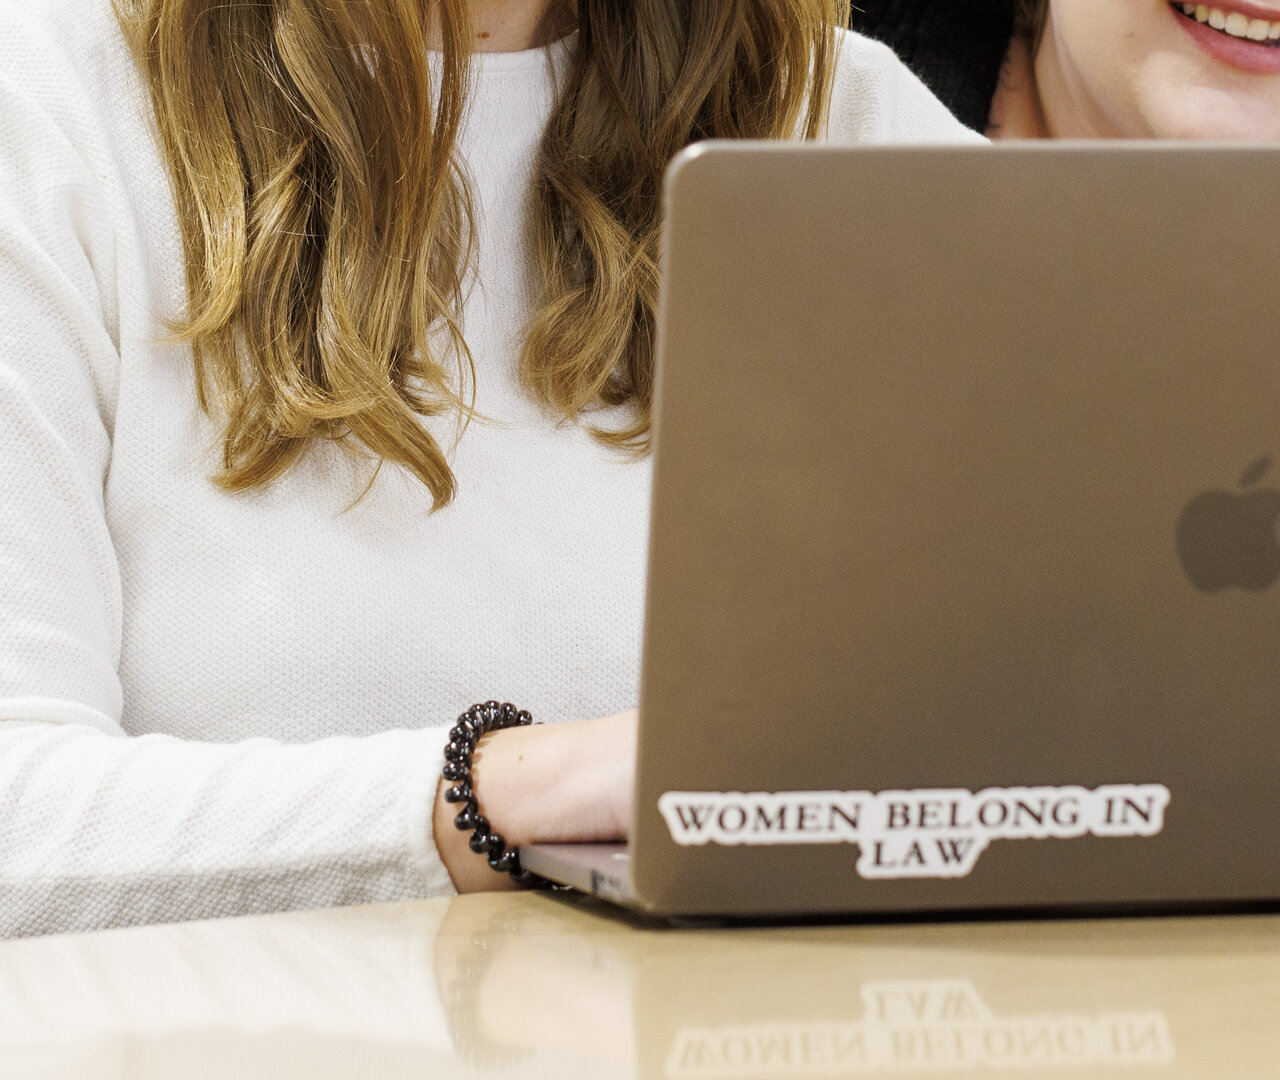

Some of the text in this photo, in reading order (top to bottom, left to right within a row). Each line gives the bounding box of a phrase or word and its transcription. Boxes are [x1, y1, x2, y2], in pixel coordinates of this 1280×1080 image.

[673, 795, 1154, 834] WOMEN BELONG IN
[873, 838, 976, 867] LAW
